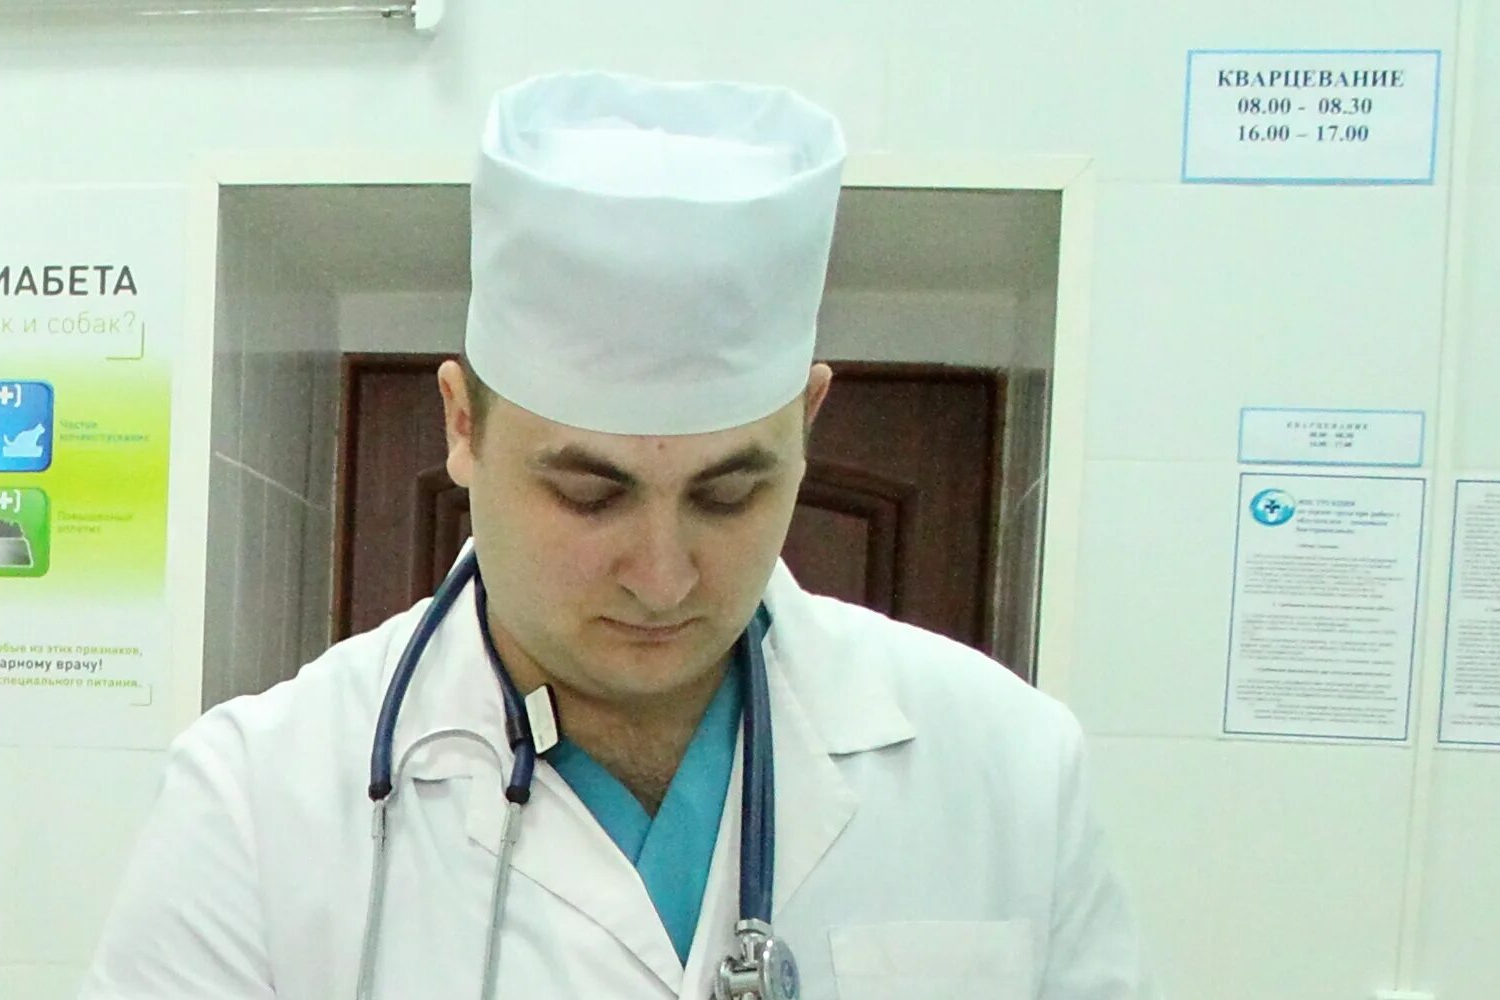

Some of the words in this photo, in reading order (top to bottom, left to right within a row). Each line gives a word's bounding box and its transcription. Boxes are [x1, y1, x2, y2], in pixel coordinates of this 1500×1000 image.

[1216, 69, 1405, 90] КВАРЦЕВАНИЕ
[1237, 97, 1292, 115] 08.00
[1318, 97, 1373, 115] 08.30
[1237, 124, 1290, 143] 16.00
[1316, 125, 1370, 143] 17.00
[23, 316, 39, 335] и
[46, 309, 136, 336] собак?
[56, 658, 103, 673] врачу!
